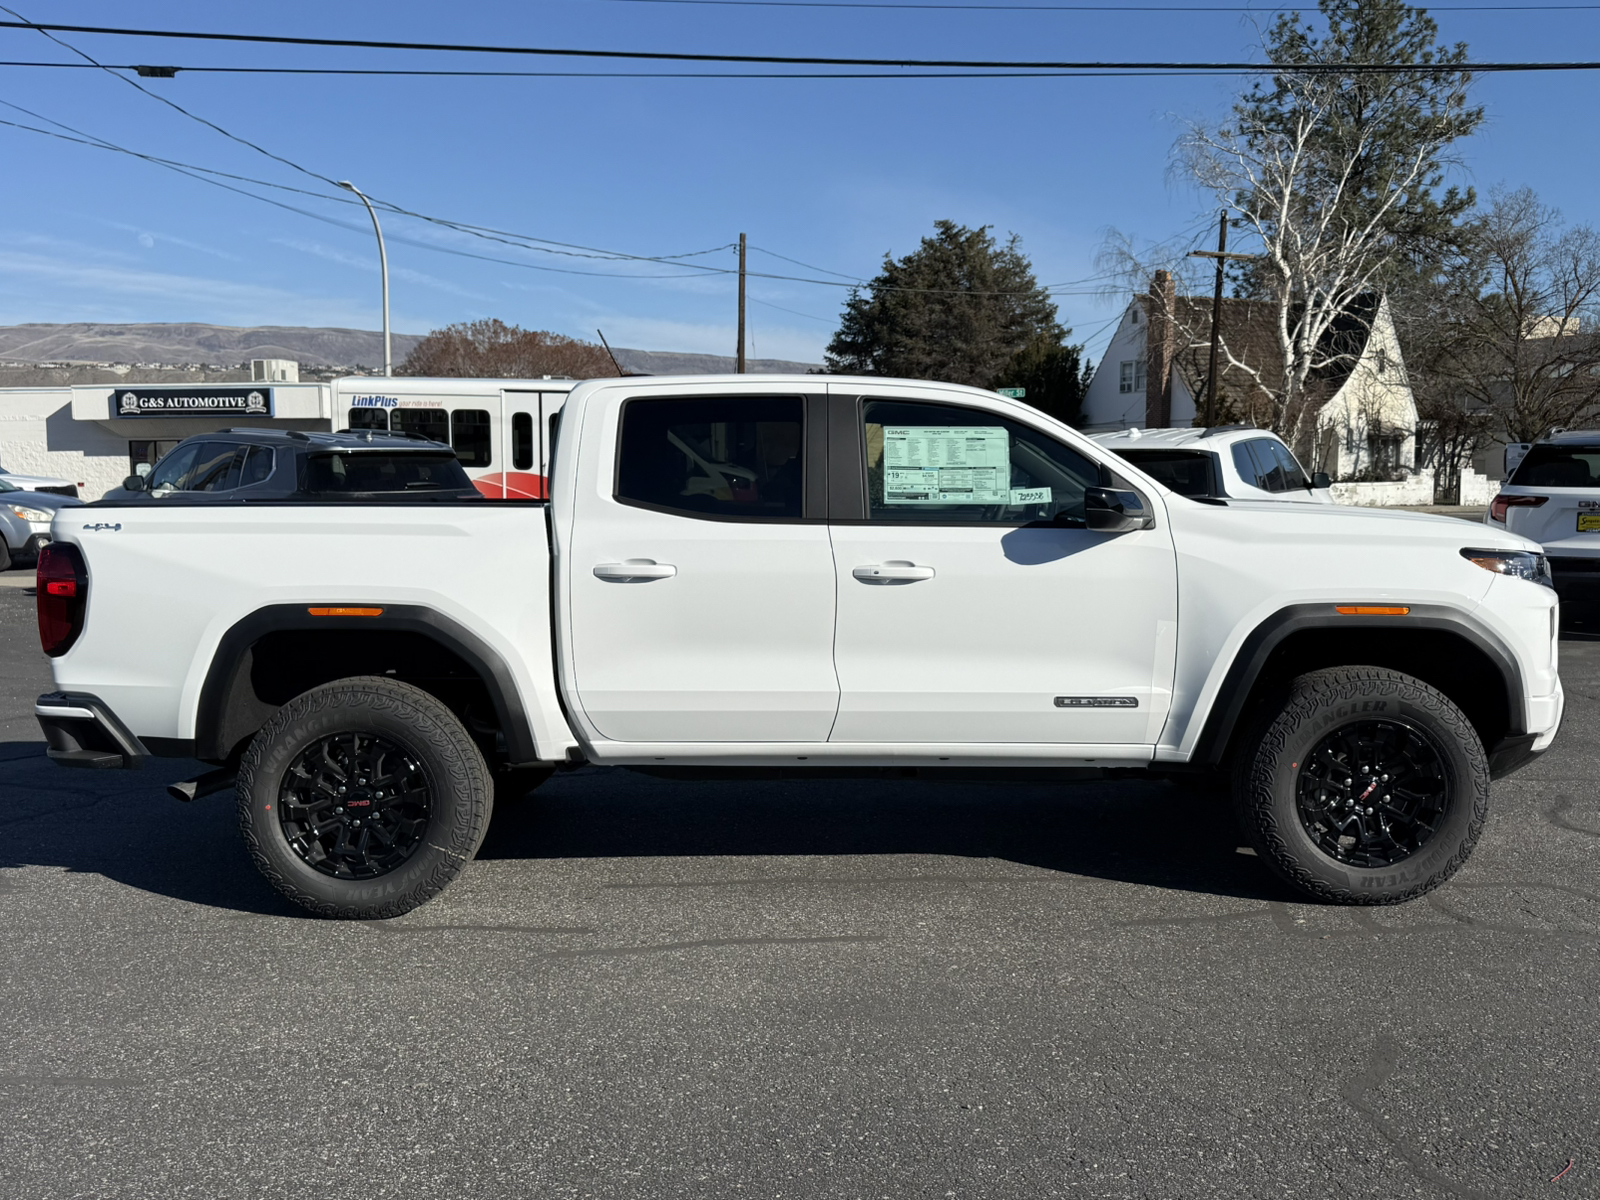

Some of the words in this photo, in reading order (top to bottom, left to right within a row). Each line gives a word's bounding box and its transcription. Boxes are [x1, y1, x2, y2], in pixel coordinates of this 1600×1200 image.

[139, 397, 165, 408] G&S
[166, 396, 246, 408] AUTOMOTIVE
[351, 395, 398, 407] LinkPlus
[263, 712, 359, 774] WRANGLER
[1287, 700, 1388, 758] WRANGLER
